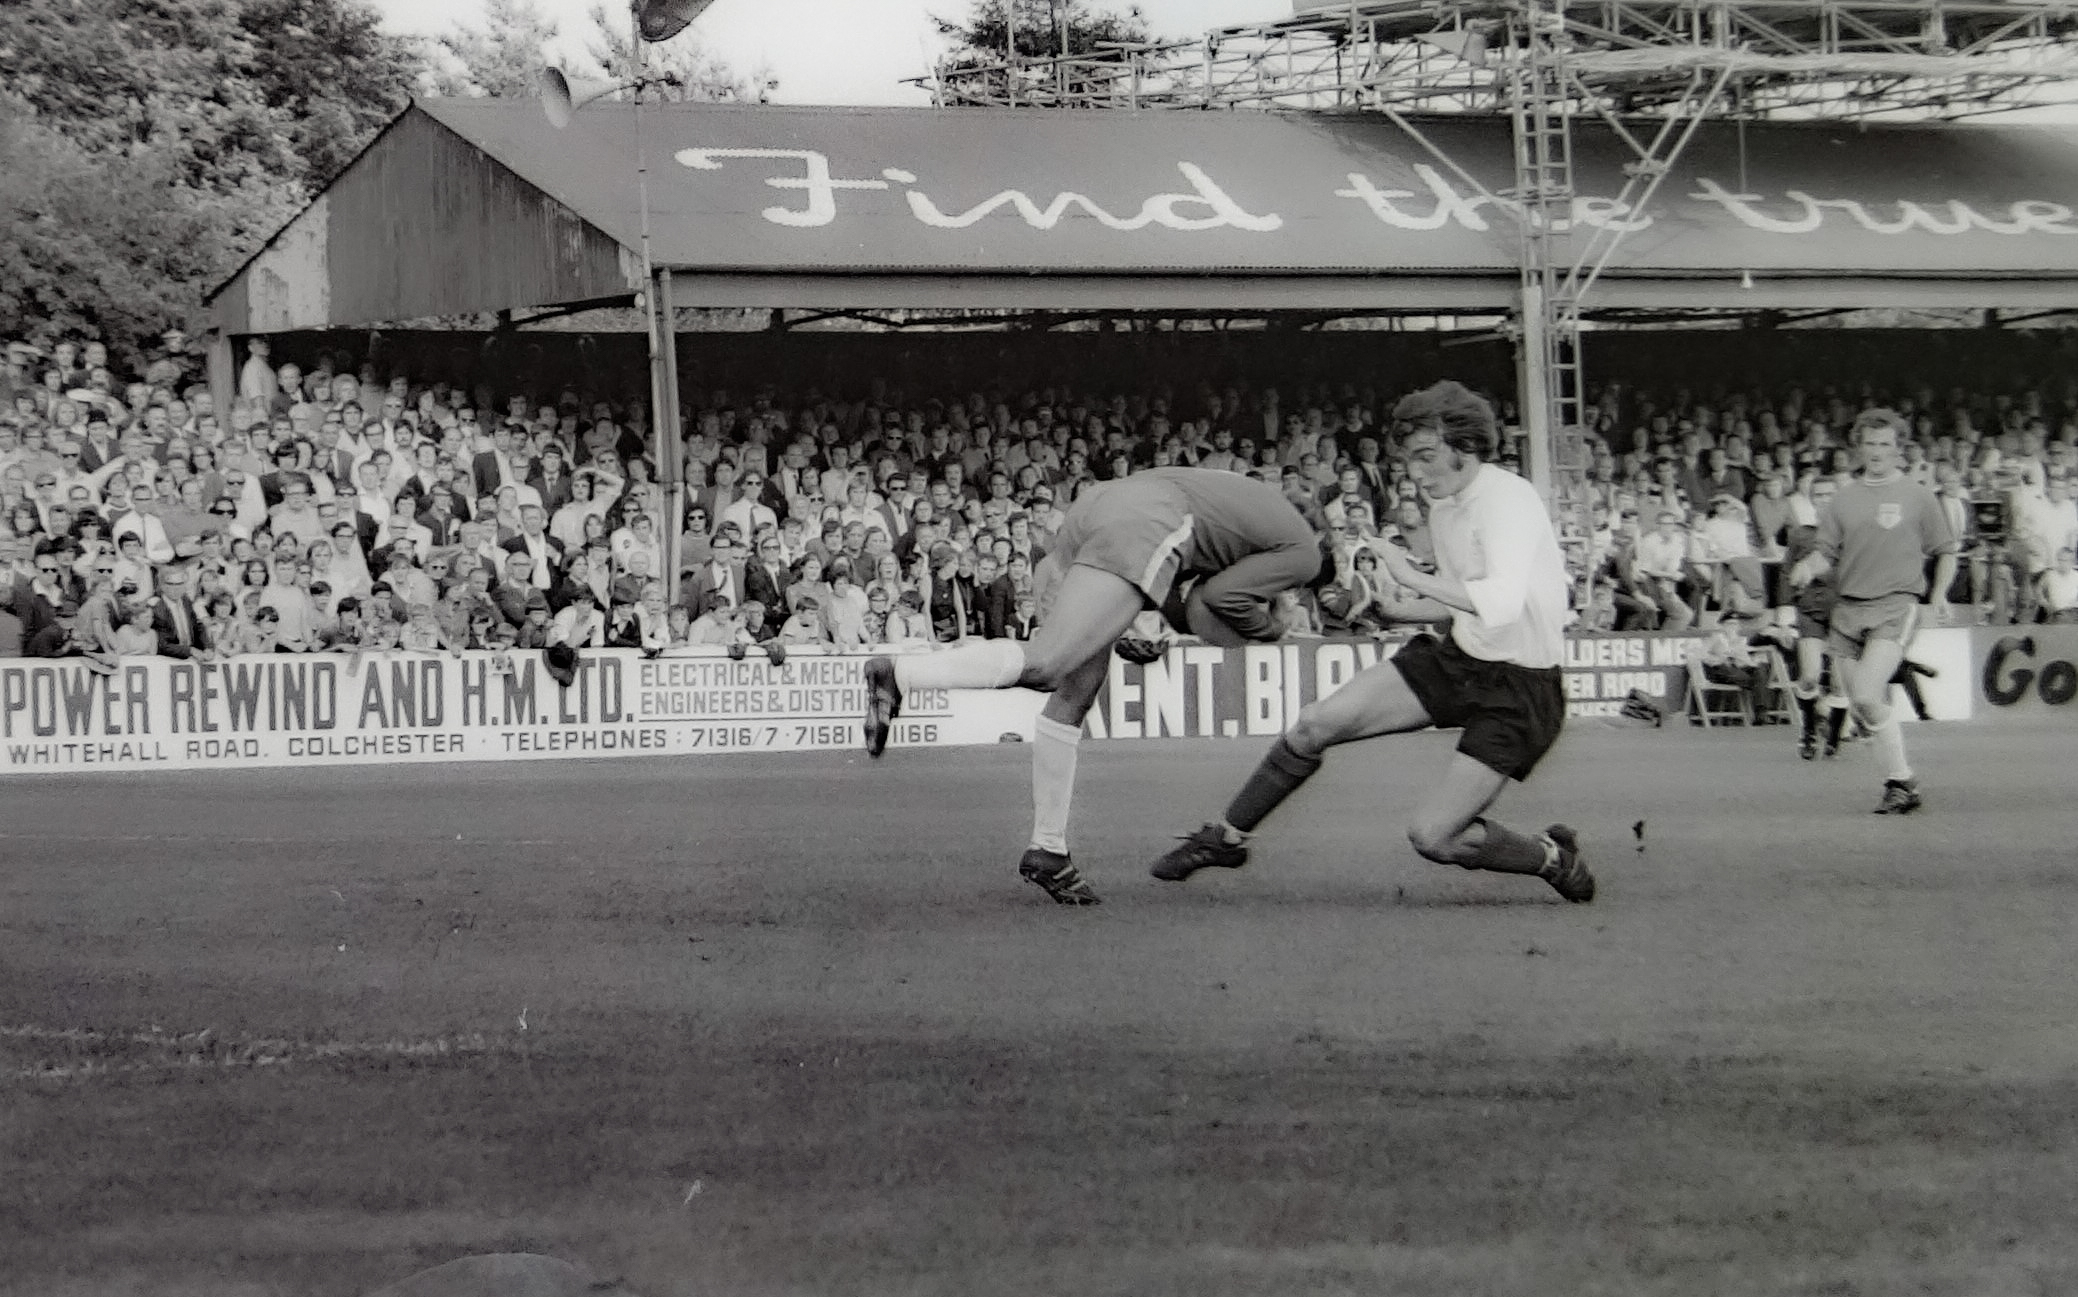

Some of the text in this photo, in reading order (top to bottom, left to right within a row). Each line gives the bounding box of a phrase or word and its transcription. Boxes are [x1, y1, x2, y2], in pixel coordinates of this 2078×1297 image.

[674, 147, 1283, 231] Find
[800, 660, 868, 686] MECH
[1566, 638, 1645, 667] LDERS
[1983, 636, 2077, 706] Go
[2, 666, 151, 738] POWER
[170, 661, 337, 733] REWIND
[358, 659, 444, 729] AND
[640, 688, 763, 715] ENGINEERS
[789, 685, 949, 713] DISTRIORS
[8, 741, 168, 764] WHITEHALL
[288, 734, 465, 757] COLCHESTER
[691, 726, 779, 747] 71316/7
[794, 725, 852, 745] 71581
[892, 723, 939, 744] 1166
